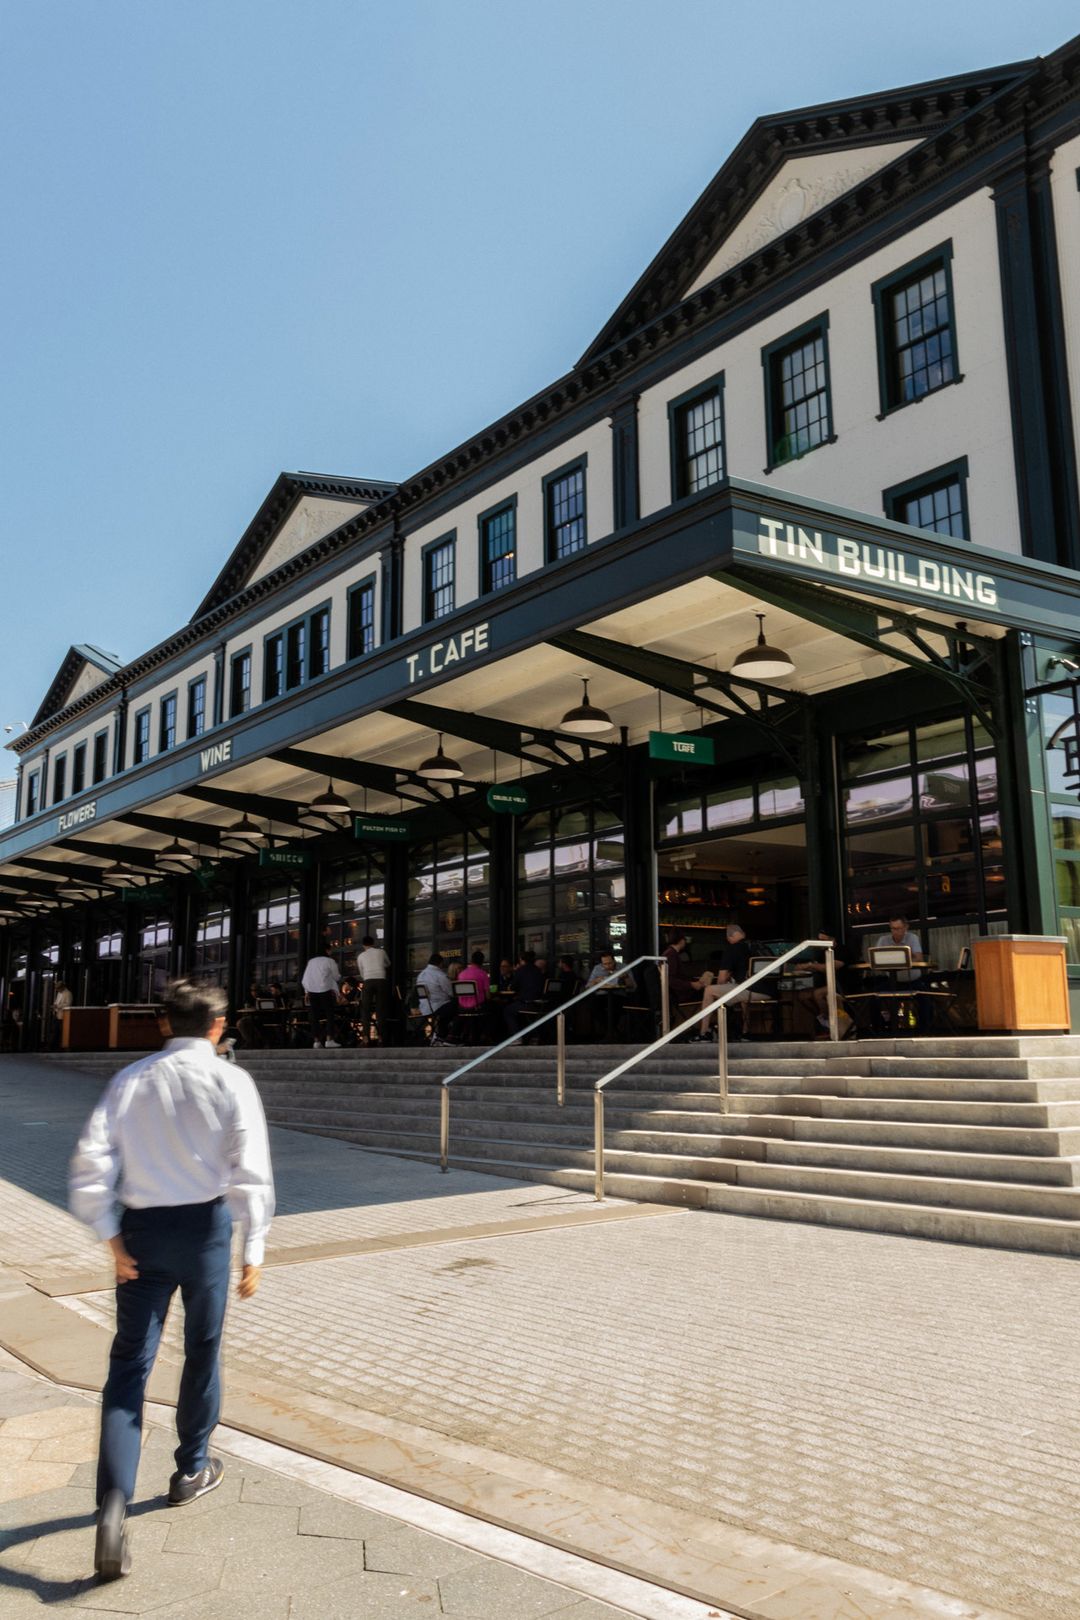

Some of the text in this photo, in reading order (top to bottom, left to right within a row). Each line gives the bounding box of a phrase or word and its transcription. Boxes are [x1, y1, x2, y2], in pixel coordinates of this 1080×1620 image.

[759, 517, 998, 606] TIN BUILDING
[406, 622, 489, 683] T. CAFE
[200, 740, 232, 772] WINE
[58, 801, 97, 832] FLOWERS
